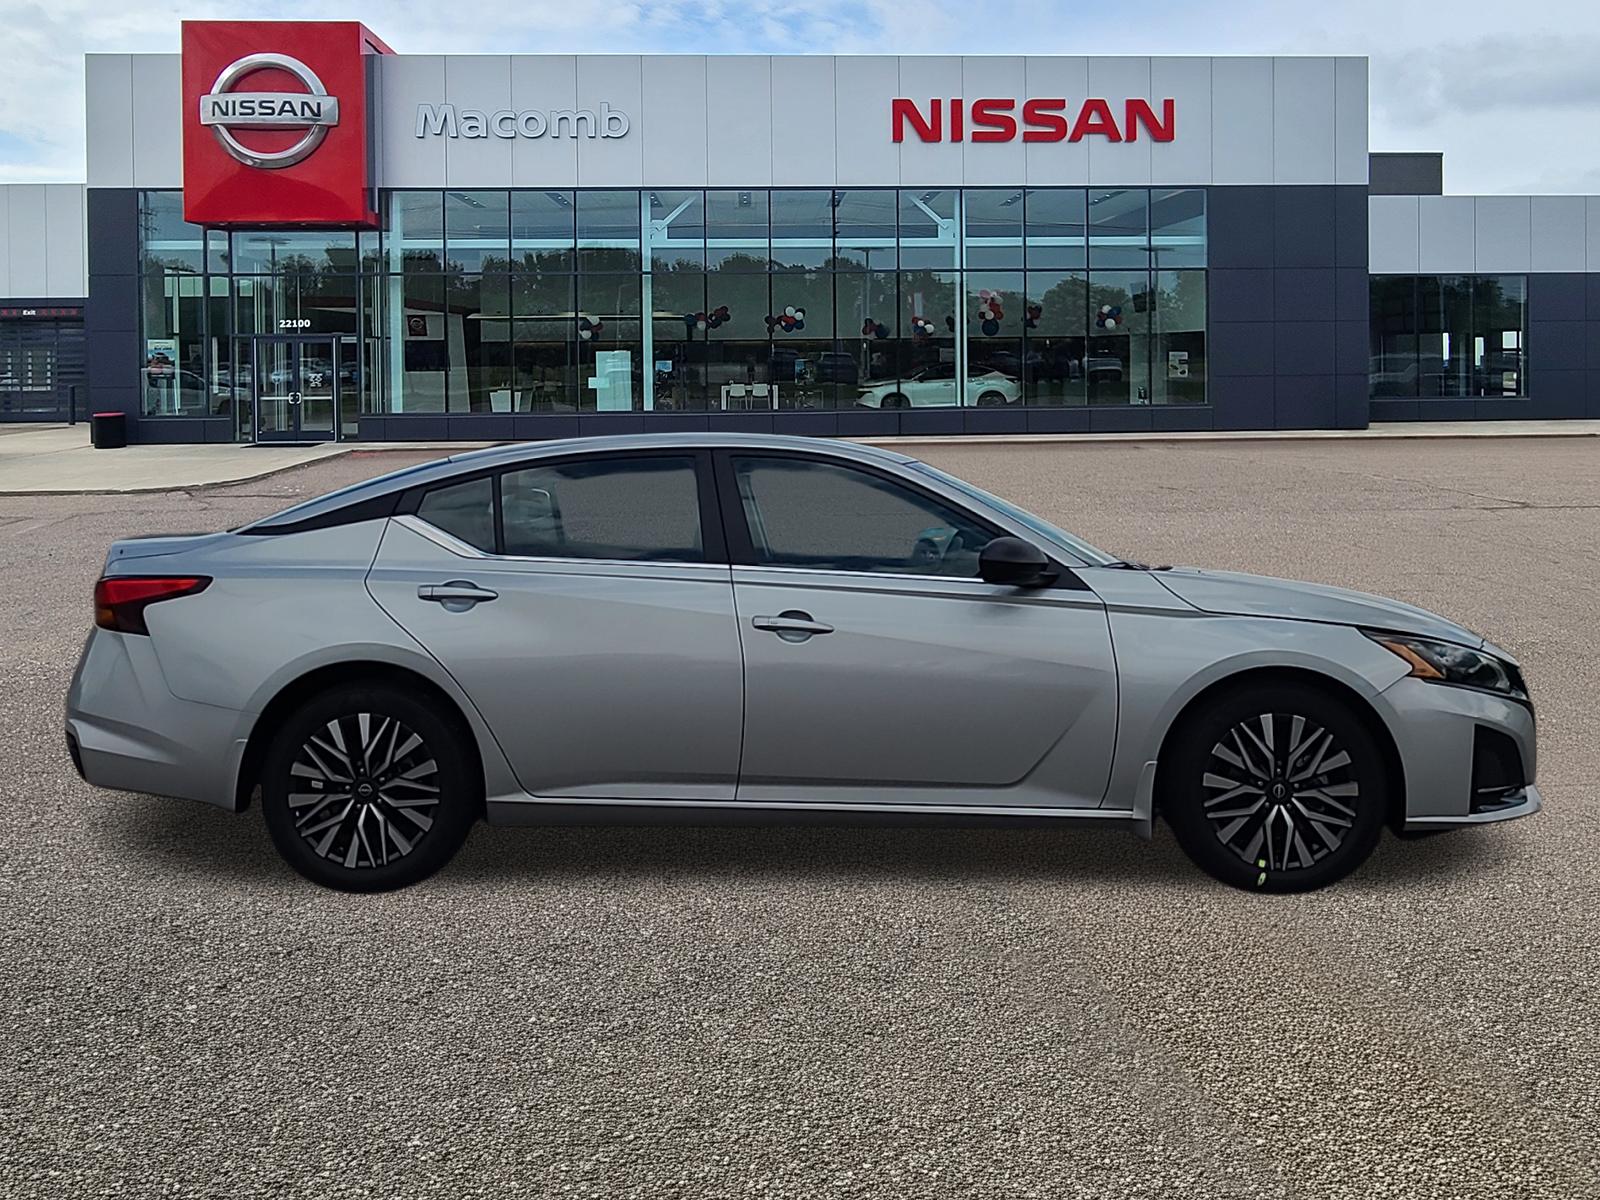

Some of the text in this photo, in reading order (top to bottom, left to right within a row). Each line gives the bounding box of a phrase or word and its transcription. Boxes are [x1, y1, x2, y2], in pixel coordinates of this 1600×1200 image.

[212, 100, 322, 118] NISSAN
[415, 102, 630, 139] Macomb
[892, 98, 1175, 143] NISSAN
[279, 319, 311, 328] 22100
